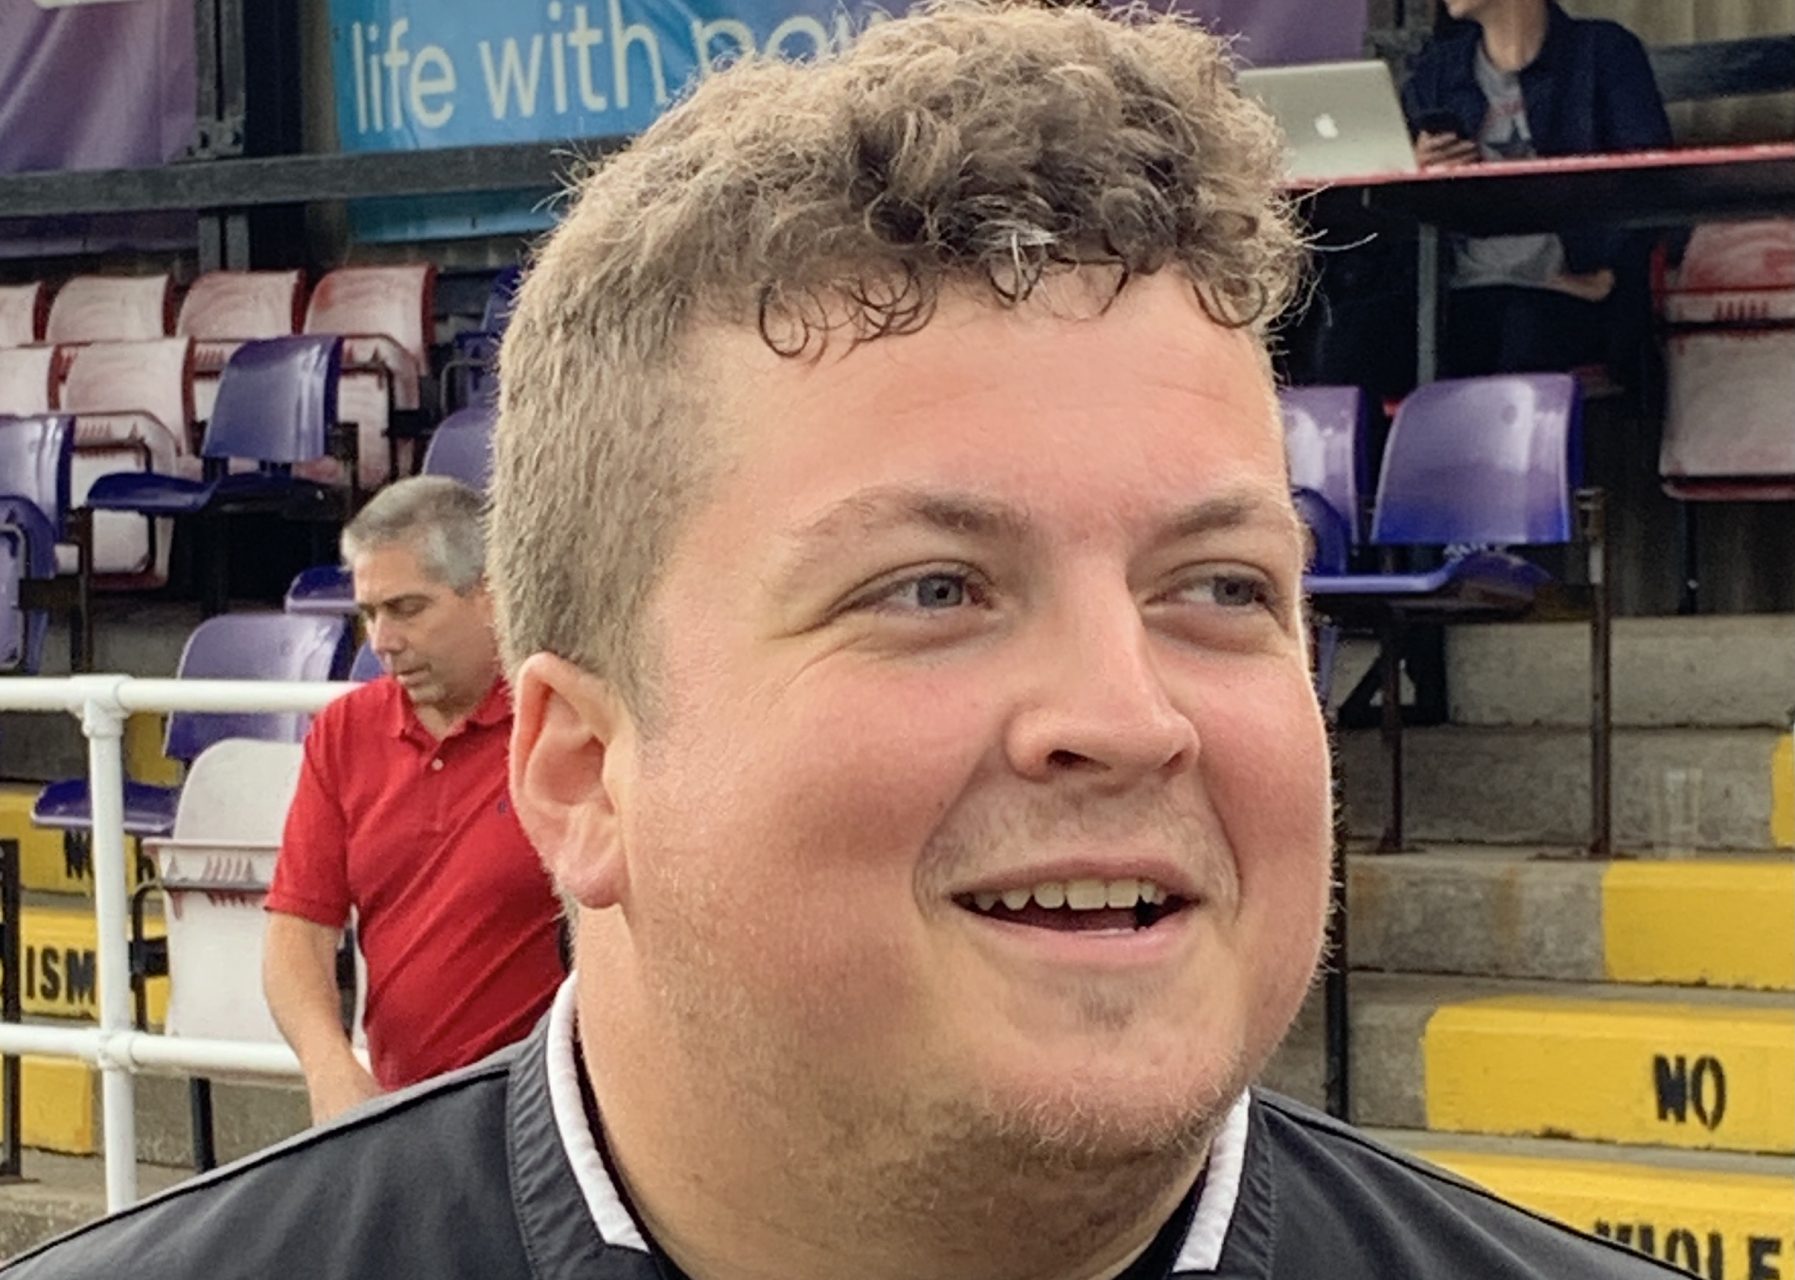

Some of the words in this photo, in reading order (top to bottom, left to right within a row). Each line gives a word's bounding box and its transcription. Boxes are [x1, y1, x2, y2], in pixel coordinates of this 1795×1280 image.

[352, 17, 457, 134] life
[478, 0, 667, 120] with
[691, 13, 888, 80] po
[1653, 1053, 1727, 1133] NO
